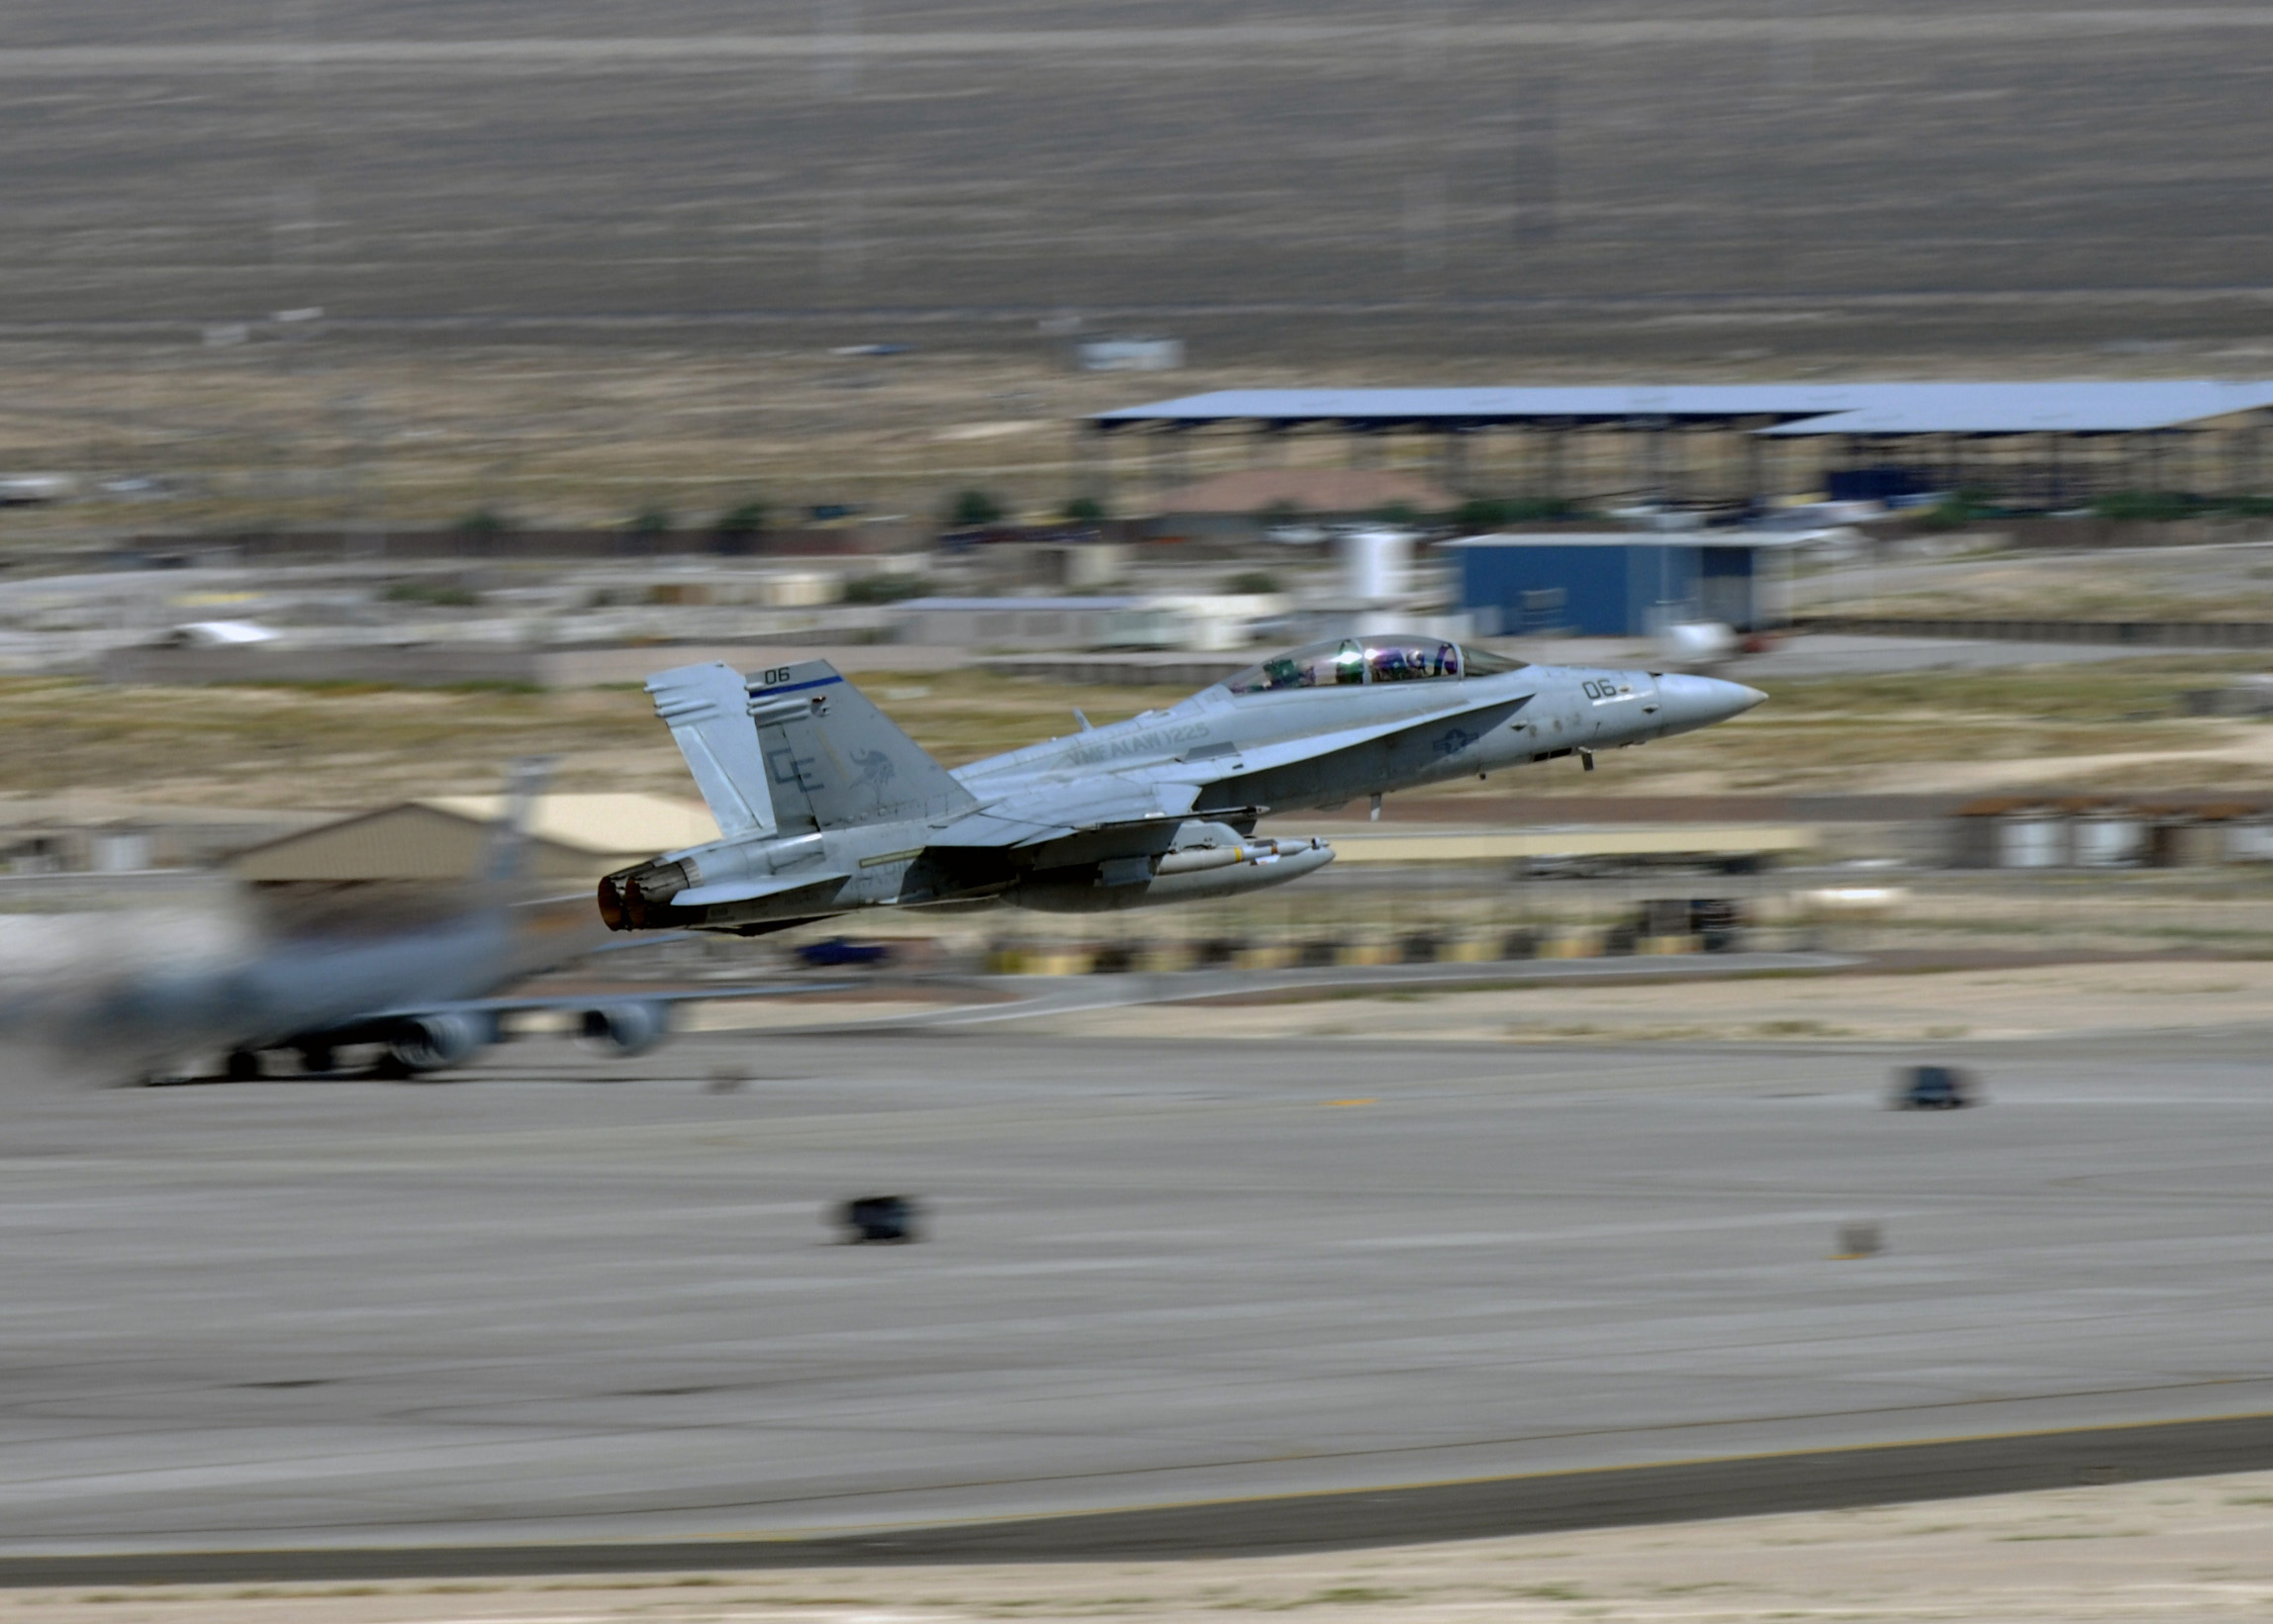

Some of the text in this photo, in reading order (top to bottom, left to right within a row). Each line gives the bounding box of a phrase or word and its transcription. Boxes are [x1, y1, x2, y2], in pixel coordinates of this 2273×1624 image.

[765, 666, 791, 685] 06
[1581, 679, 1617, 700] 06
[766, 747, 825, 793] CE
